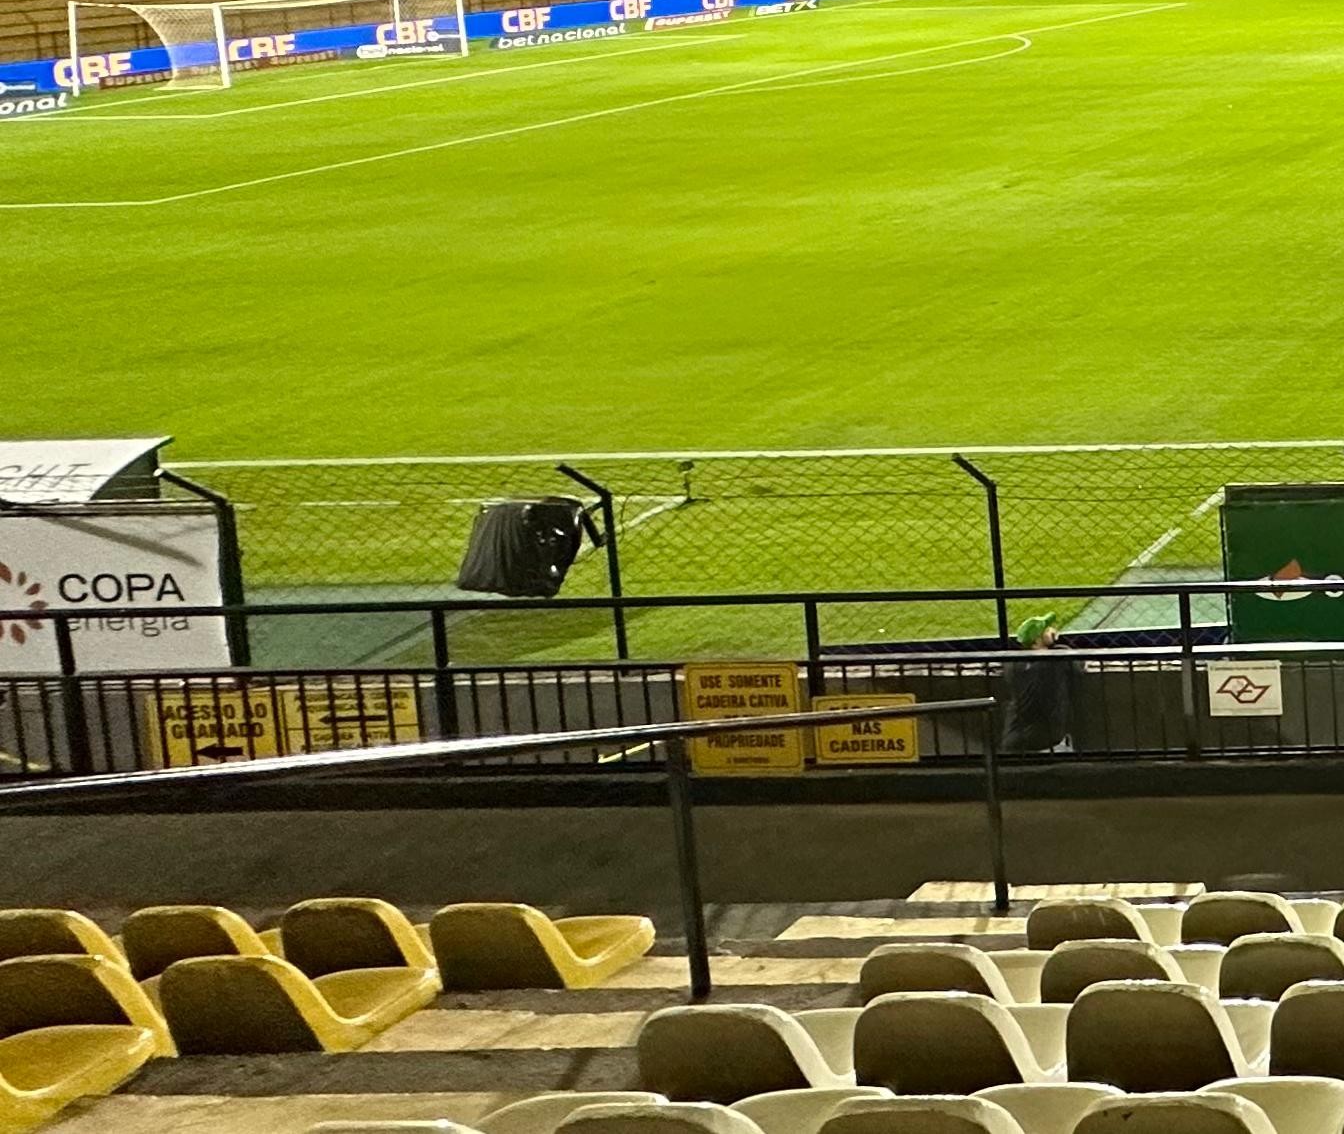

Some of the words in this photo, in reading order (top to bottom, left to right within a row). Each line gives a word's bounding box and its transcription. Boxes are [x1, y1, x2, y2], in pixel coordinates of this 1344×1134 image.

[502, 7, 552, 34] CBF
[58, 573, 186, 604] COPA
[699, 674, 722, 689] USE
[728, 674, 782, 689] SOMENTE
[696, 694, 746, 709] CADEIRA
[748, 693, 789, 708] CATIVA
[852, 722, 882, 735] NAS
[706, 733, 786, 748] PROPRIEDADE
[829, 738, 905, 753] CADEIRAS
